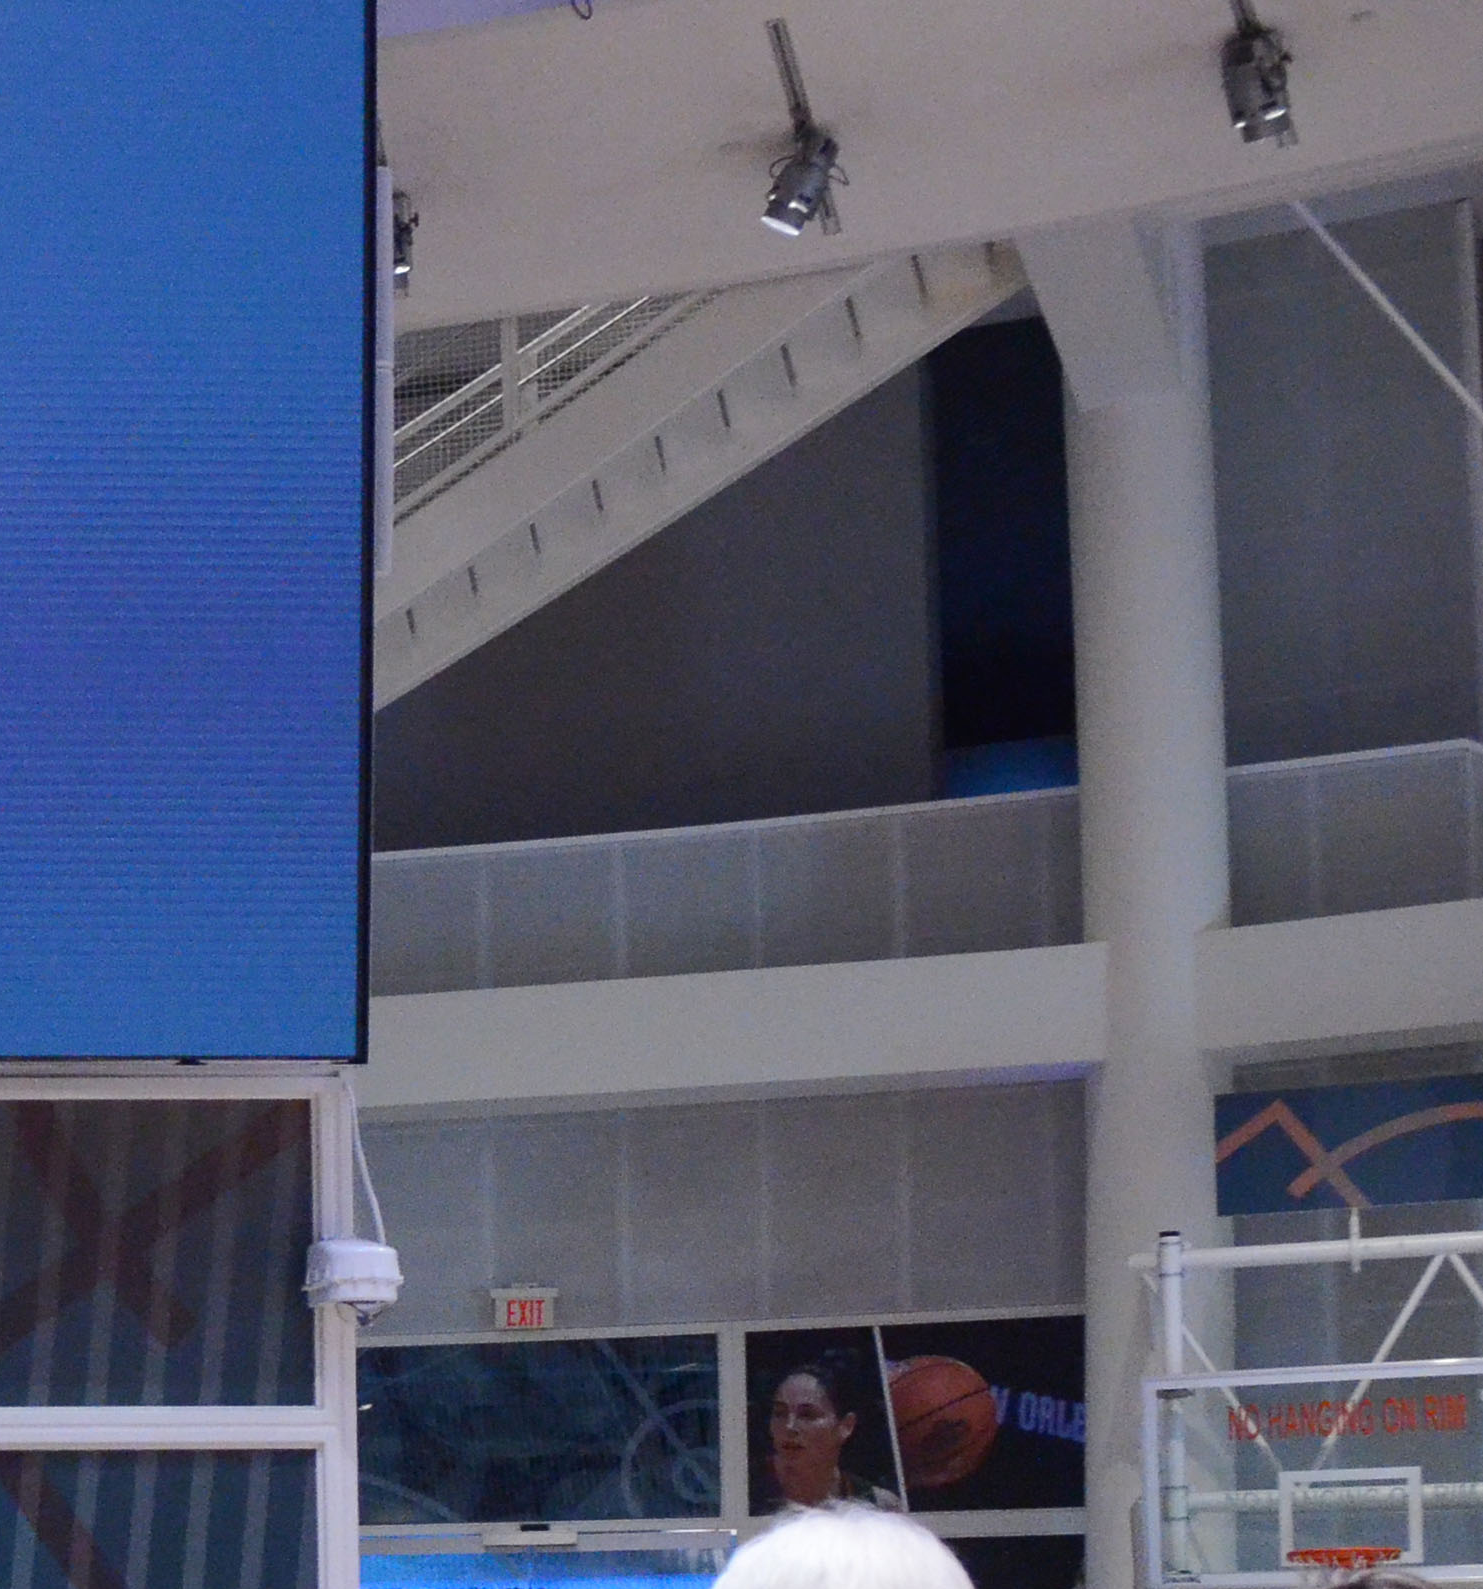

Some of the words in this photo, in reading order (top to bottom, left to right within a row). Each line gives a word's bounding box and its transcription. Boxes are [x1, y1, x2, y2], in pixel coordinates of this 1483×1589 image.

[506, 1299, 545, 1327] EXIT
[1226, 1404, 1261, 1441] NO
[1268, 1399, 1375, 1440] HANGING
[1385, 1396, 1418, 1434] ON
[1425, 1394, 1468, 1432] RIM
